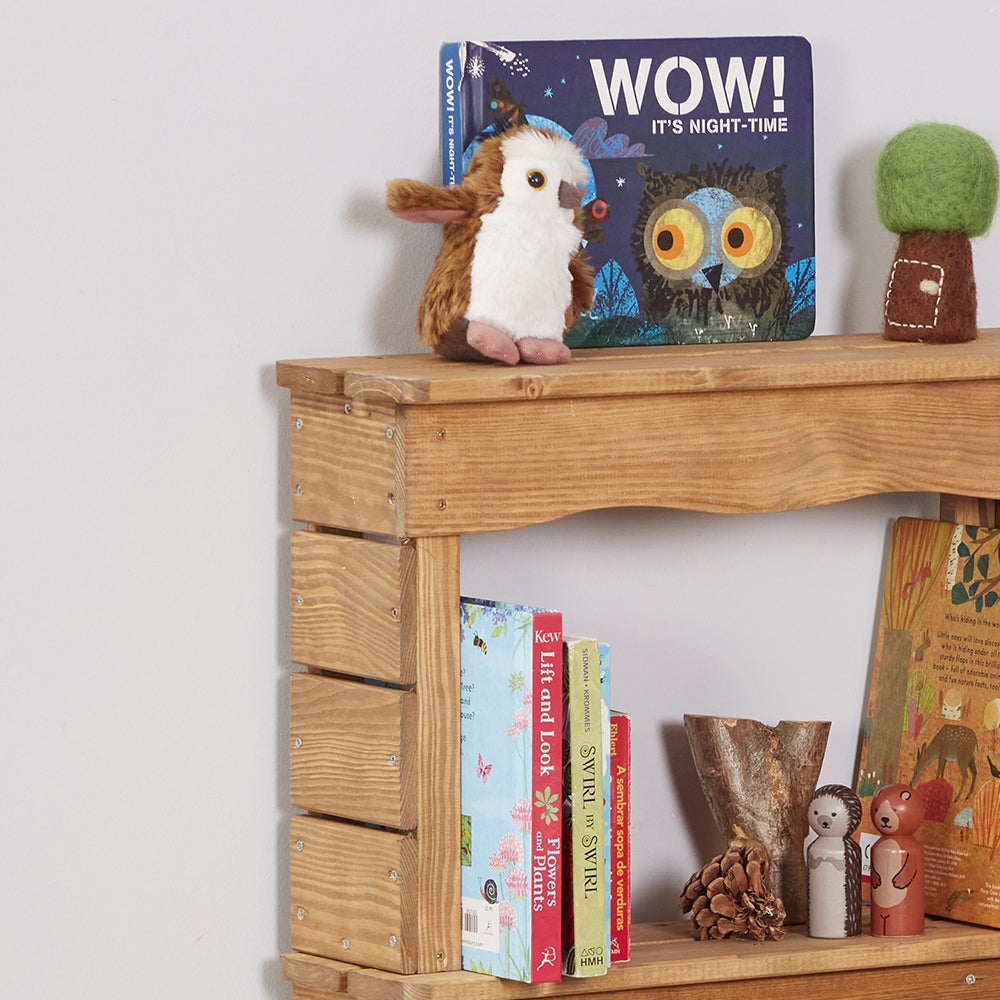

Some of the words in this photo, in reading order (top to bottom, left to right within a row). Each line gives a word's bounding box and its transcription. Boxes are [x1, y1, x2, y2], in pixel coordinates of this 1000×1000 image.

[445, 58, 455, 112] WOW!
[589, 56, 785, 115] WOW!
[448, 115, 457, 135] IT'S
[652, 119, 684, 135] IT'S
[689, 117, 788, 134] NIGHT-TIME
[448, 138, 456, 185] NIGHT-TI
[535, 630, 561, 644] Kew
[983, 618, 991, 627] the
[540, 651, 556, 684] Lift
[581, 648, 589, 682] SIDMAN
[540, 690, 555, 723] and
[583, 689, 591, 733] KROMMES
[539, 731, 555, 777] Look
[610, 723, 618, 757] Ehlert
[579, 745, 597, 810] SWIRL
[616, 765, 627, 776] A
[616, 778, 627, 827] sembrar
[585, 814, 594, 830] BY
[614, 830, 624, 860] sopa
[533, 855, 547, 912] Plants
[547, 838, 561, 908] Flowers
[581, 835, 598, 899] SWIRL
[616, 861, 627, 877] de
[616, 879, 627, 931] verduras
[580, 956, 604, 967] HMH
